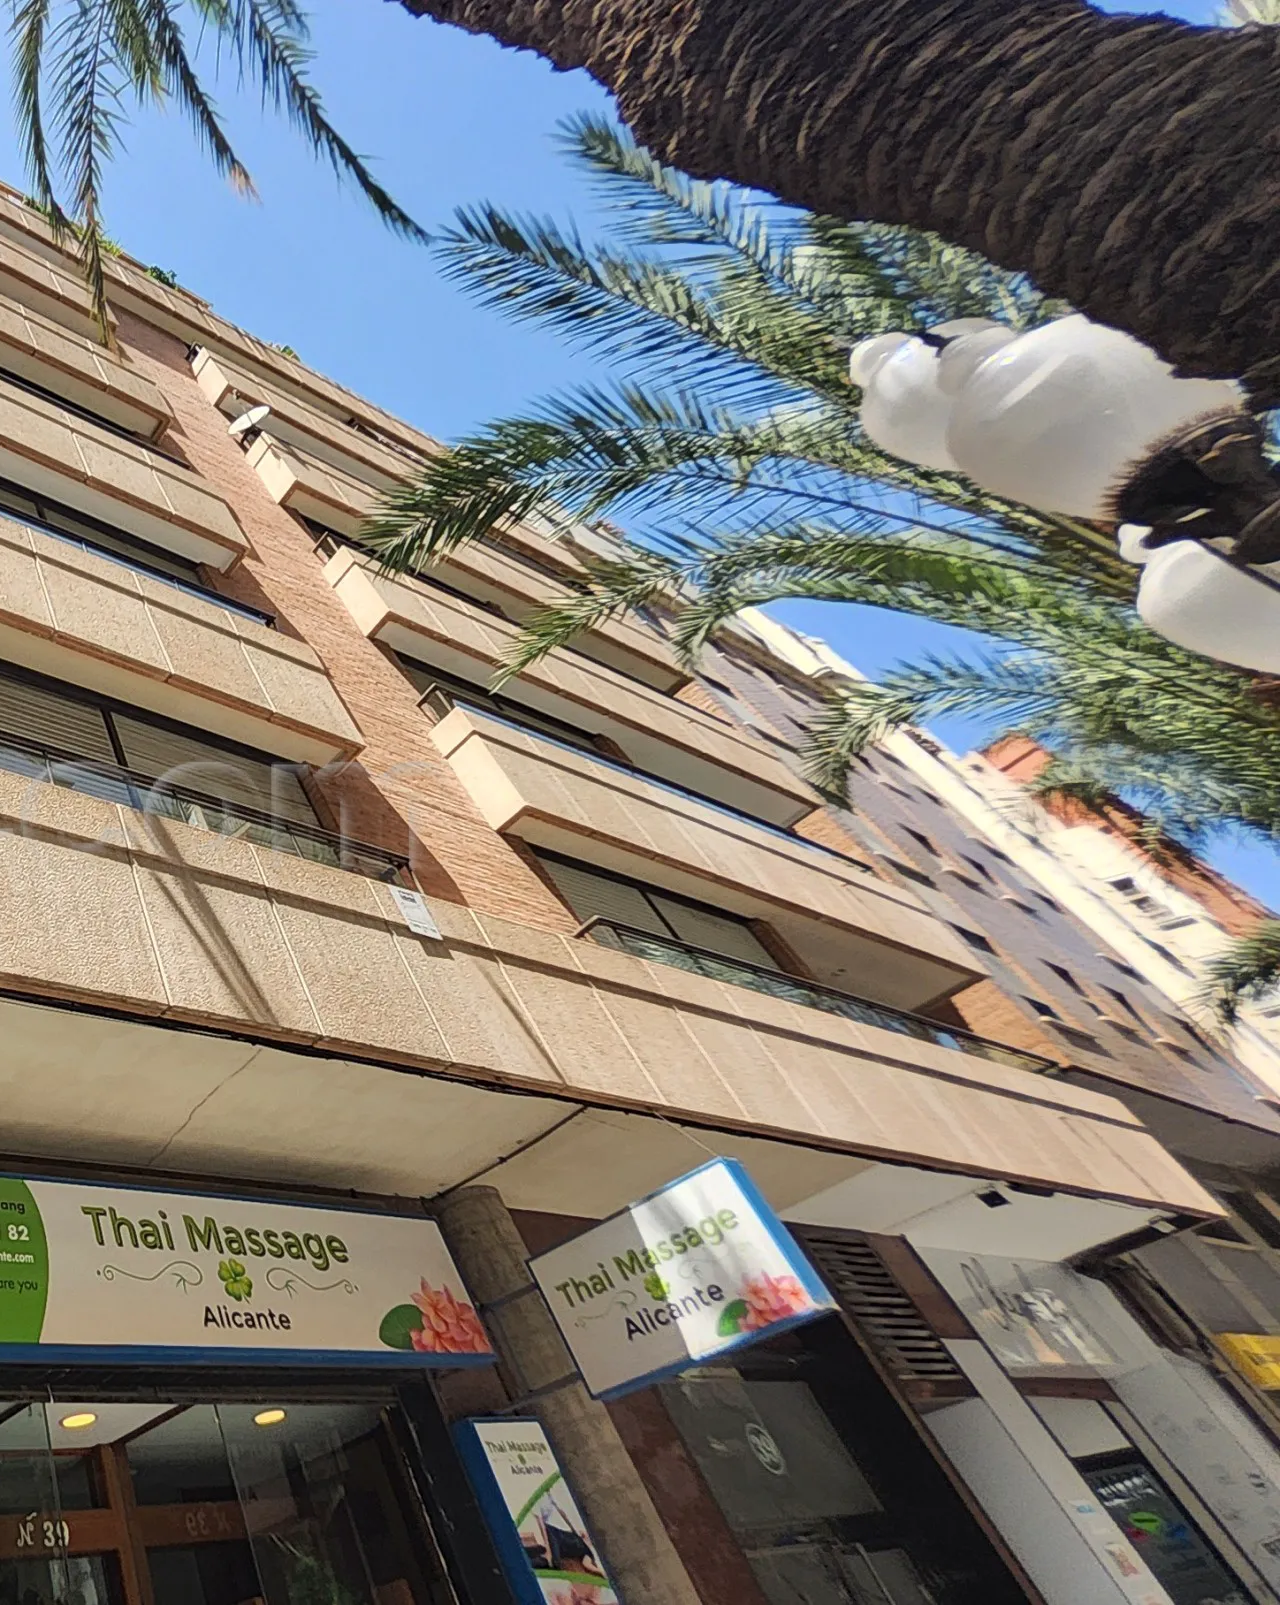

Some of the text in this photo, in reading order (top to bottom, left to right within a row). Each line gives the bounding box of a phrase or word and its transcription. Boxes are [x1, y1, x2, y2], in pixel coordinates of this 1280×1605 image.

[8, 1225, 30, 1241] 82
[80, 1205, 350, 1272] Thai Massage
[554, 1207, 740, 1308] Thai Massage
[18, 1279, 39, 1294] you
[203, 1305, 292, 1331] Alicante
[624, 1283, 725, 1342] Alicante
[485, 1440, 548, 1456] Thai Massage
[511, 1465, 543, 1476] Alicante
[43, 1520, 70, 1548] 39
